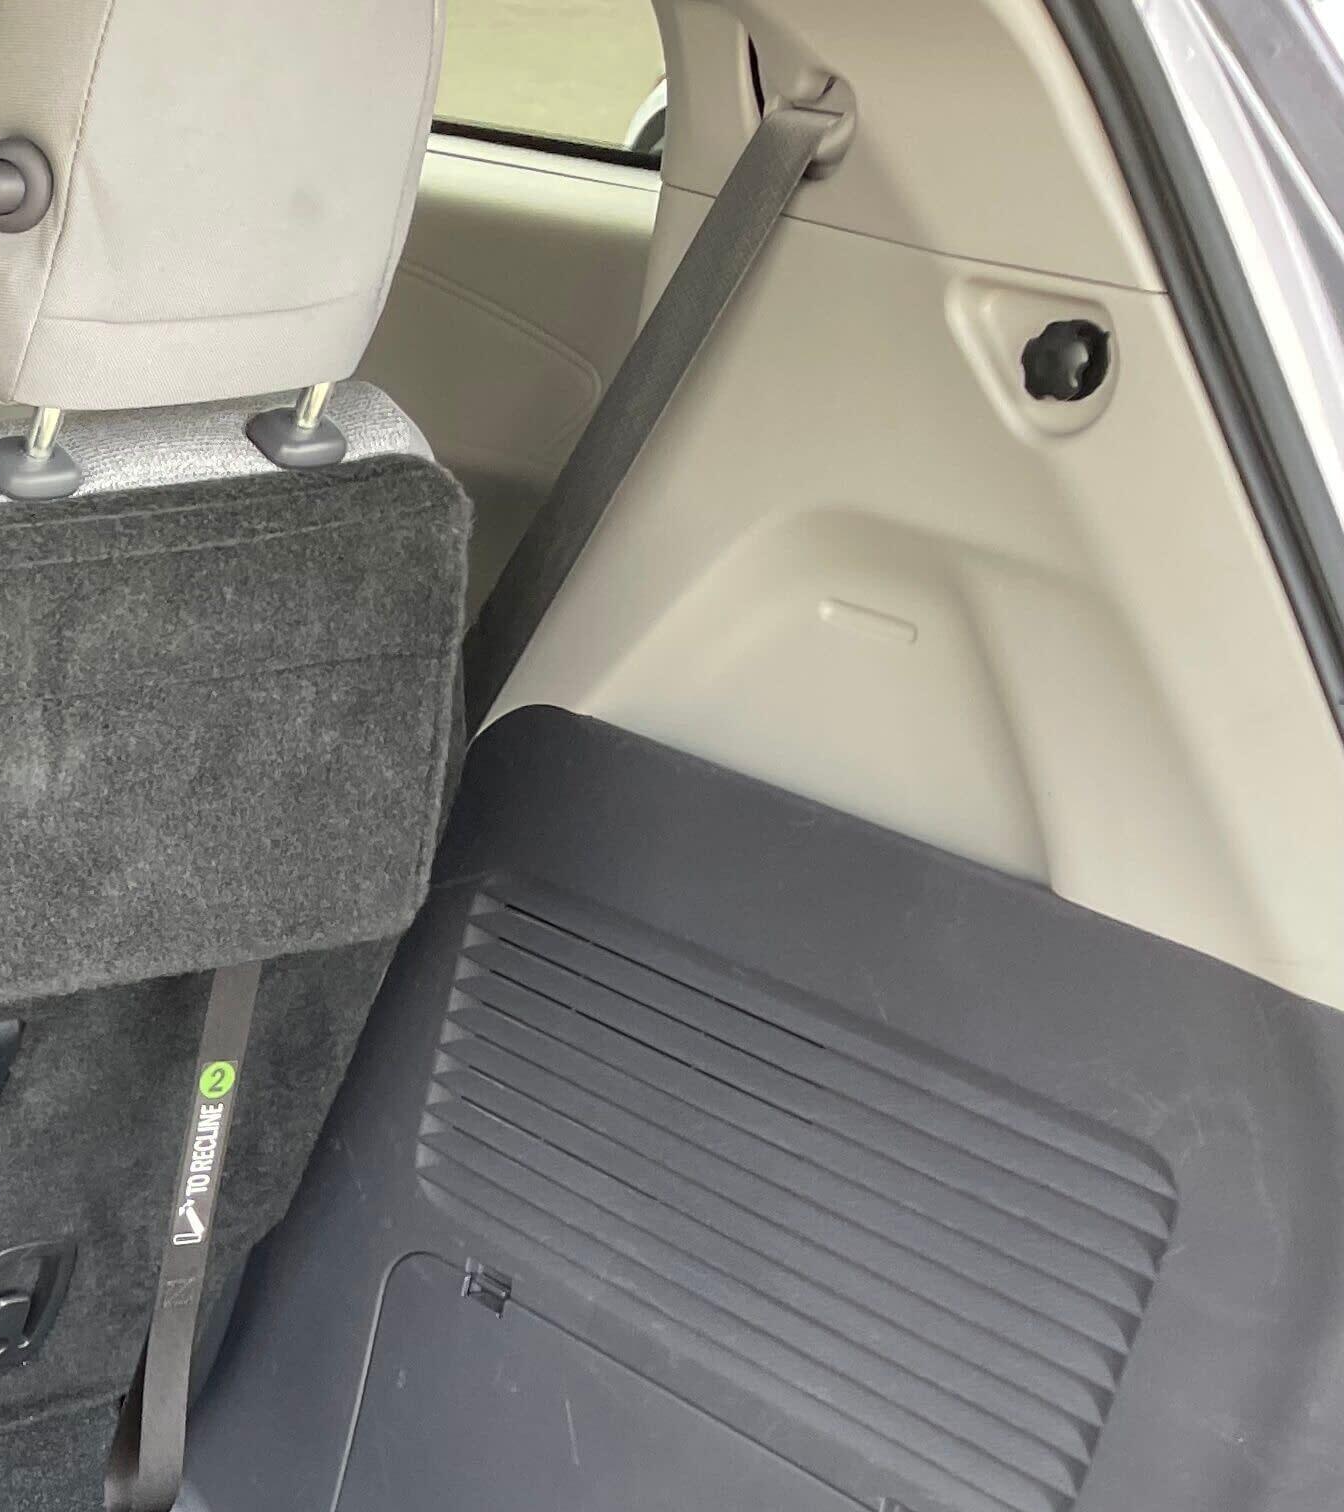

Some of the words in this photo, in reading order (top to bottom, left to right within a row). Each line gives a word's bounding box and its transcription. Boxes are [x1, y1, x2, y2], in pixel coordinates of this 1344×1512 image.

[208, 1068, 226, 1092] 2
[190, 1102, 224, 1173] RECLINE
[185, 1173, 211, 1197] TO
